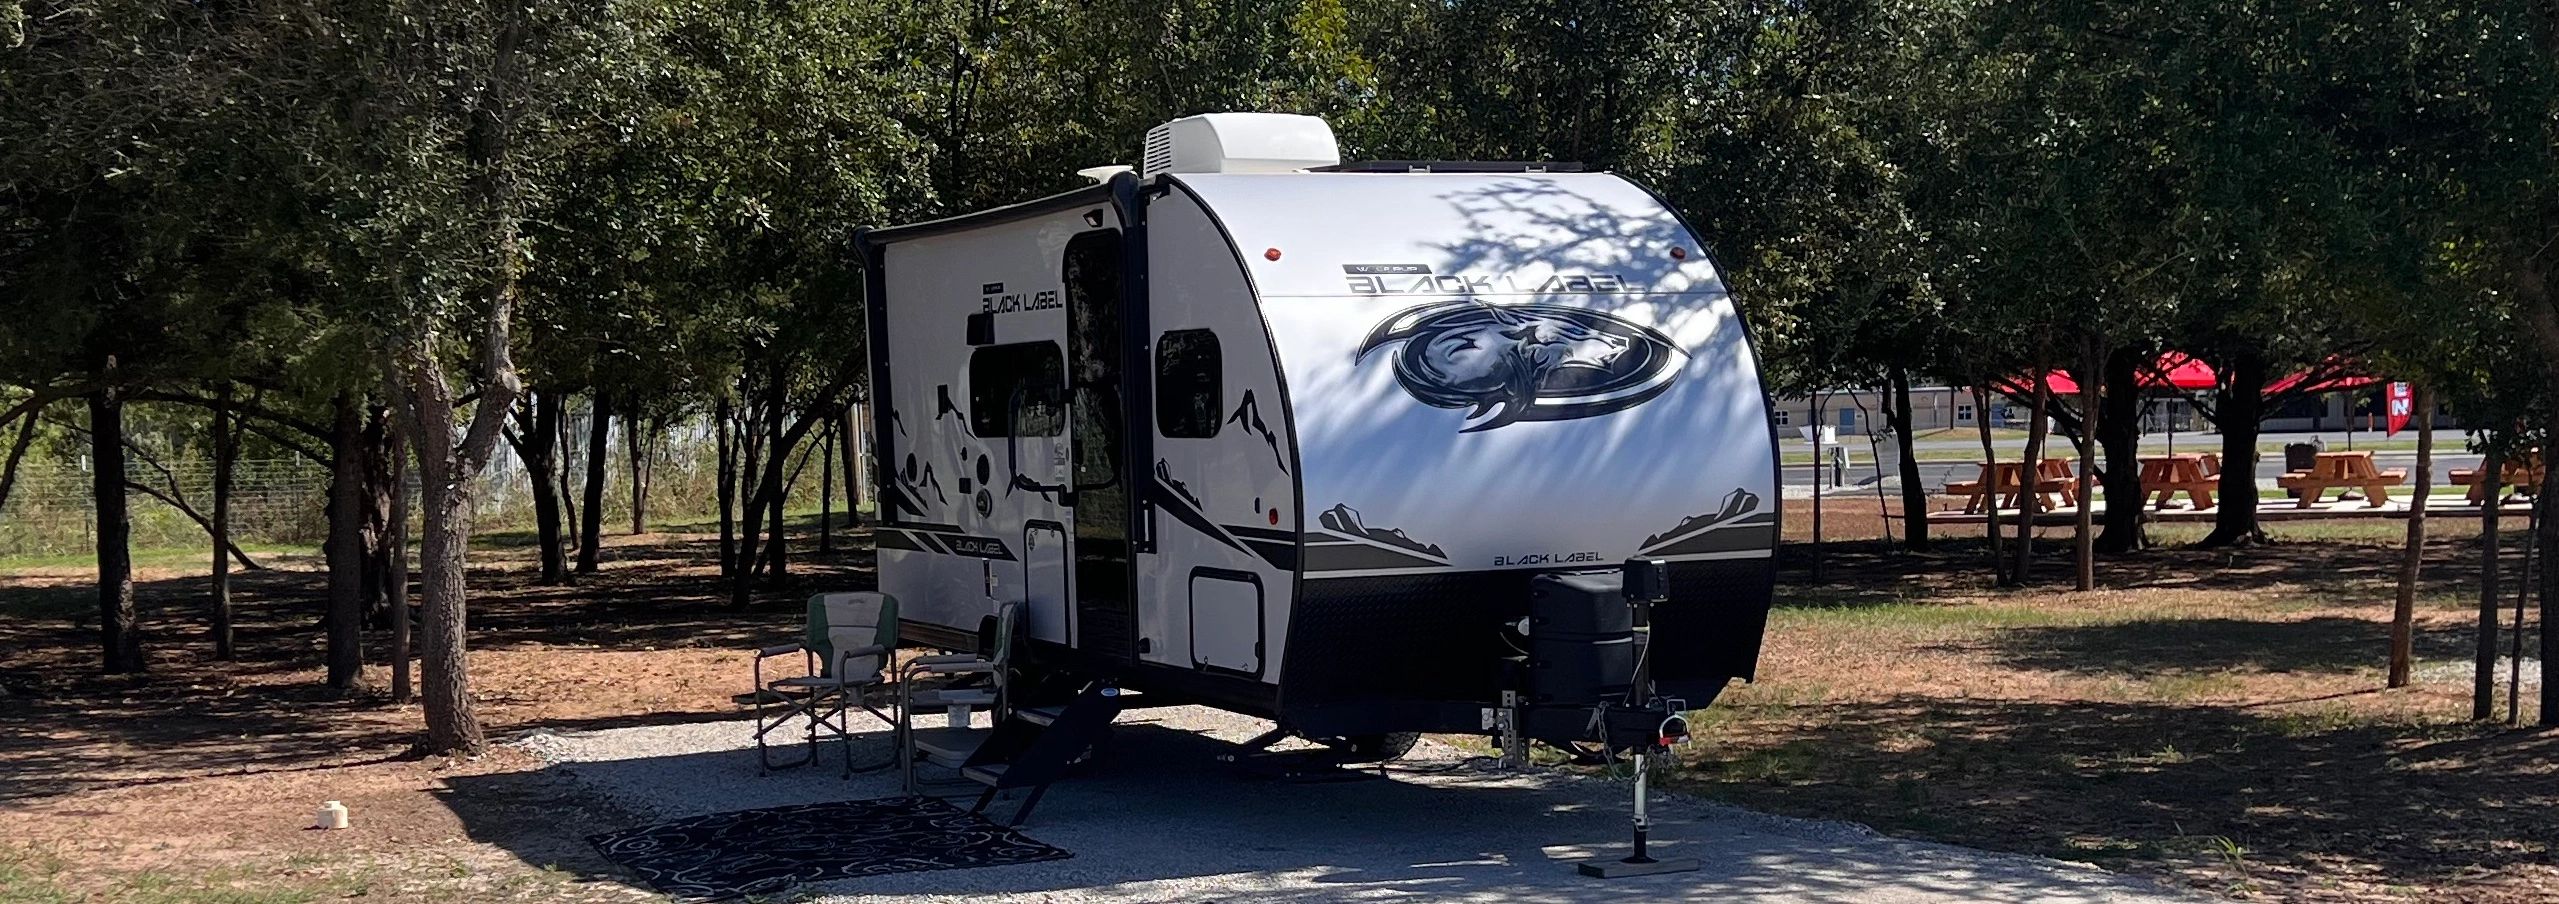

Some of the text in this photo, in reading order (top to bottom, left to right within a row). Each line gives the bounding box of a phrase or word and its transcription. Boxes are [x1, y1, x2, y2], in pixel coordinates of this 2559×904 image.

[1345, 274, 1647, 293] BLACK LABEL
[982, 290, 1063, 314] BLACK LABEL
[1494, 551, 1604, 566] BLACK LABEL
